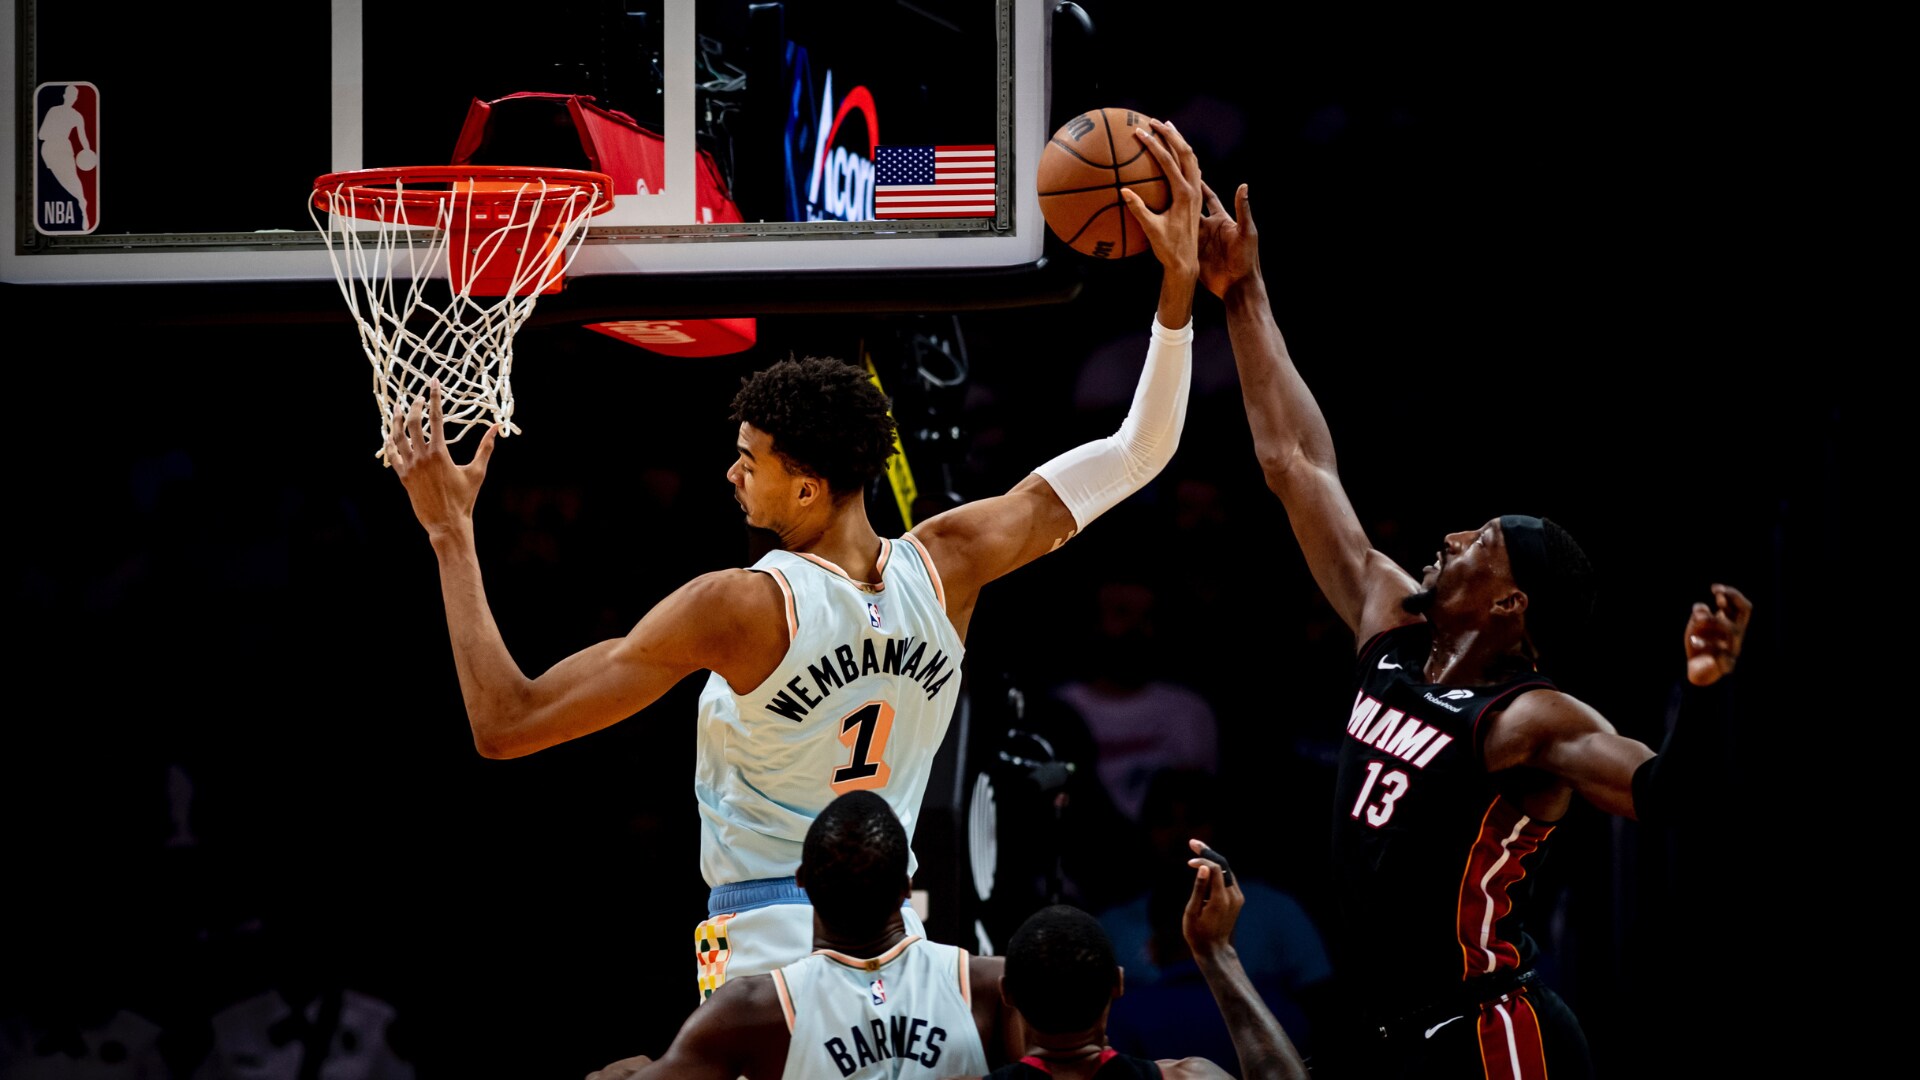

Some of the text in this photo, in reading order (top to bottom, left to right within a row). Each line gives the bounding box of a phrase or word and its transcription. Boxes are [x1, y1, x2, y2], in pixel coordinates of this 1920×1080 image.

[44, 201, 75, 224] NBA
[1346, 687, 1454, 769] MIAMI
[1423, 692, 1463, 713] Robinhood
[831, 700, 893, 791] 1
[1350, 760, 1411, 829] 13
[824, 1015, 947, 1078] BARNES
